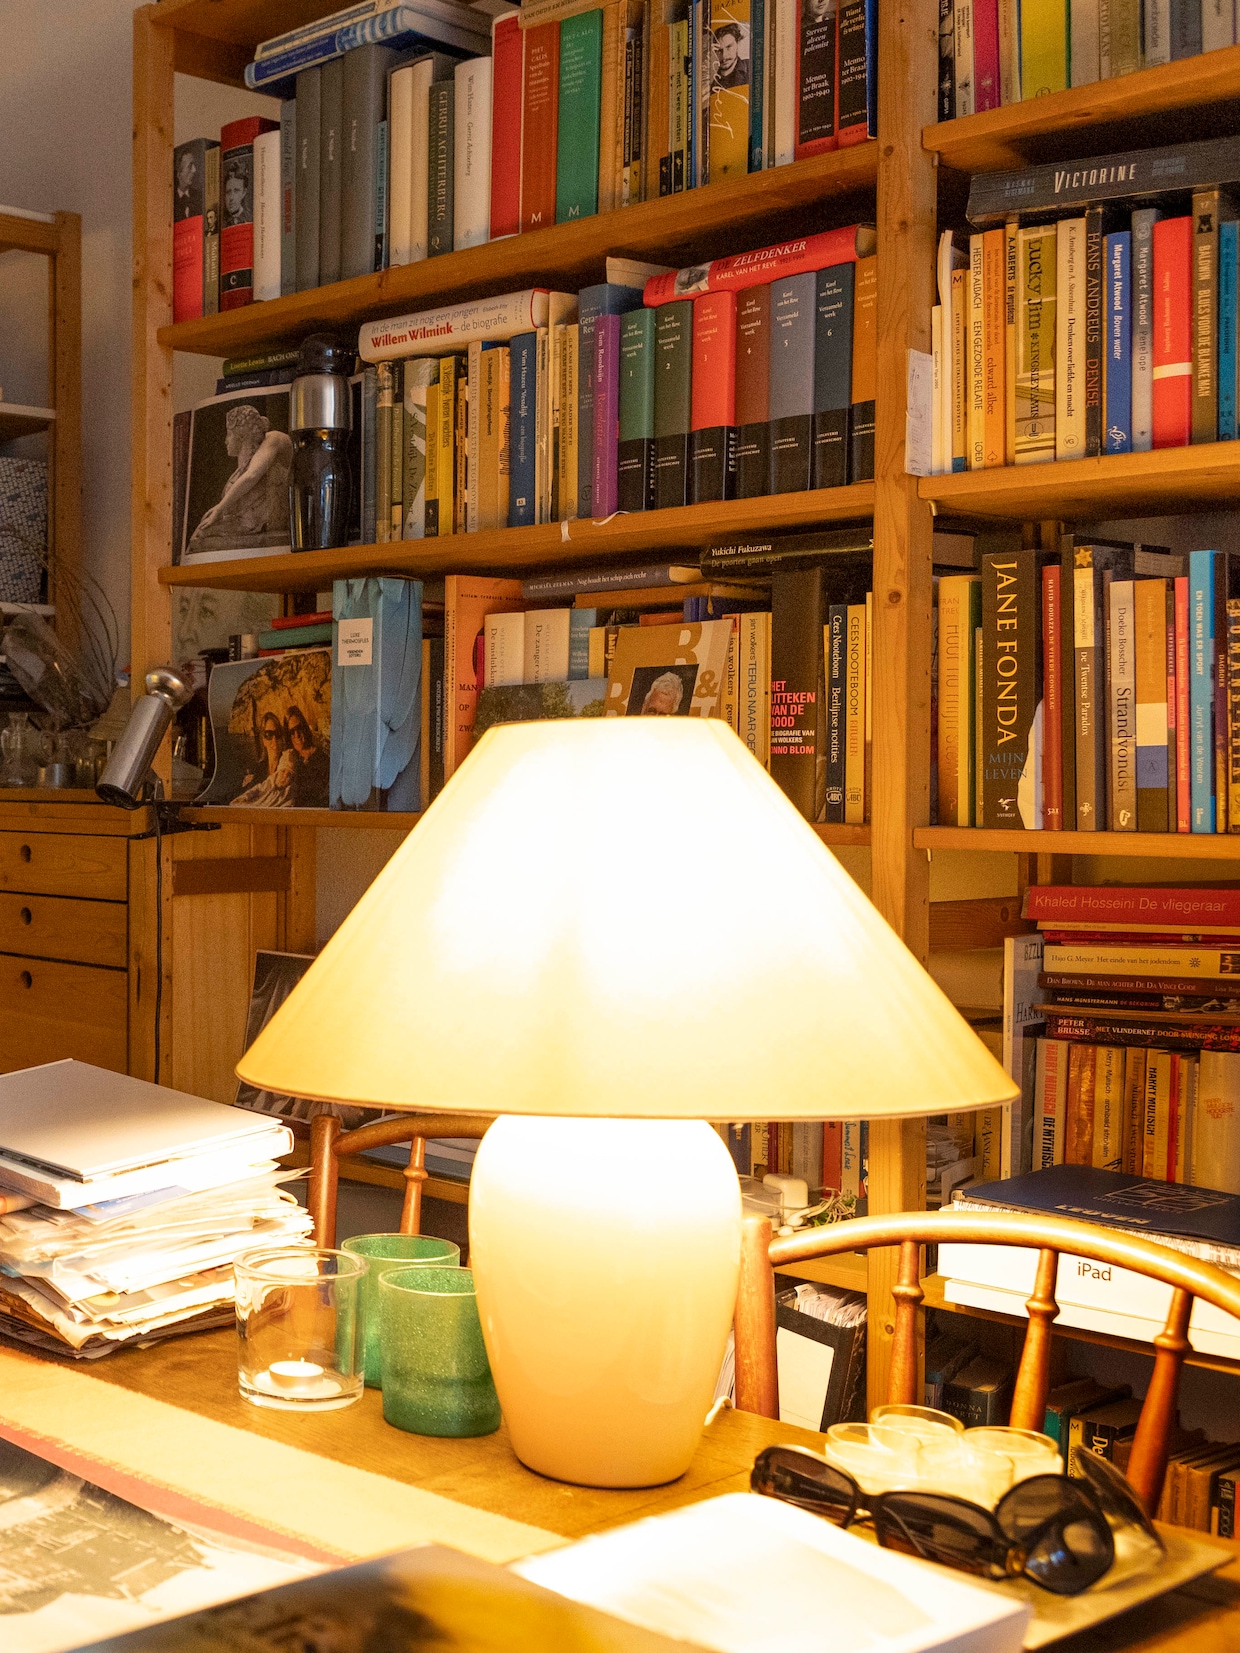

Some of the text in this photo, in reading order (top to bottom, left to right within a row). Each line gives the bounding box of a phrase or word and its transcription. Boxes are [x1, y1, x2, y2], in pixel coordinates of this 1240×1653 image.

[805, 74, 826, 84] Menno
[811, 80, 829, 90] Braak
[436, 91, 447, 221] GERRIT ACHTERBERG
[1054, 164, 1137, 193] VICTORINE
[532, 212, 542, 223] M
[568, 205, 579, 217] M
[1069, 226, 1076, 234] K.
[733, 240, 807, 267] ZELFDENKER
[716, 271, 734, 280] KAREL
[736, 268, 748, 277] VAN
[749, 264, 759, 274] HET
[760, 260, 777, 272] REVE
[1068, 265, 1074, 273] en
[1068, 283, 1076, 314] Steenhuis
[1111, 244, 1123, 360] Margaret Atwood Boven water
[1087, 232, 1100, 407] HANS ANDREUS DENISE
[1137, 247, 1149, 372] Margaret Atwood Penelope
[973, 247, 983, 410] HESTER ALBACH EEN GEZONDE RELATIE
[1027, 239, 1043, 418] Lucky Jim KINGSLEY AMIS
[1197, 244, 1210, 397] BALDWIN BLUES VOOR DE BLANKE MAN
[371, 314, 507, 348] Willem Wilmink de biografie
[827, 329, 832, 337] 6
[1067, 318, 1075, 346] Denken
[1067, 363, 1075, 382] liefde
[986, 357, 997, 415] edward albee
[1067, 384, 1073, 393] en
[1066, 394, 1075, 417] macht
[711, 542, 772, 557] Yukichi Fukuzawa
[1195, 590, 1203, 601] EN
[1195, 602, 1203, 621] TOEN
[749, 618, 757, 629] jan
[1195, 622, 1203, 639] WAS
[749, 631, 757, 660] wolkers
[1048, 636, 1054, 645] DE
[1195, 640, 1203, 650] ER
[990, 560, 1018, 746] JANE FONDA
[1080, 651, 1088, 661] De
[1195, 652, 1203, 676] SPORT
[747, 661, 757, 698] TERUG
[829, 616, 842, 763] Cees Nooteboom Berlijnse notities
[850, 617, 860, 757] CEES NOOTEBOOM RITUELEN
[1080, 664, 1090, 699] Twentse
[459, 704, 470, 712] OP
[790, 704, 804, 715] DE
[1116, 607, 1133, 794] Doeko Bosscher Strandvondst
[747, 700, 756, 731] NAAR
[1079, 702, 1091, 736] Paradox
[1194, 704, 1205, 726] Jurryt
[790, 746, 814, 754] BLOM
[988, 752, 1025, 764] MIJN
[1196, 745, 1204, 755] de
[985, 770, 1027, 780] LEVEN
[1195, 757, 1205, 784] Vooren
[1035, 895, 1228, 915] Khaled Hosseini De vliegeraar
[1051, 954, 1065, 962] Hajo
[1075, 955, 1094, 964] Meyer
[1109, 956, 1126, 964] einde
[1150, 957, 1180, 966] jodendom
[1057, 1027, 1090, 1036] BRUSSE
[1112, 1026, 1156, 1036] VLINDERNET
[1180, 1031, 1218, 1041] SWINGING
[1045, 1044, 1058, 1074] HARRY
[1043, 1075, 1057, 1115] MULISCH
[1102, 1050, 1113, 1158] Harry Mulisch archibald strohalm
[1147, 1067, 1157, 1136] HARRY MULISCH
[983, 1116, 992, 1128] DE
[1042, 1117, 1055, 1127] DE
[1077, 1262, 1112, 1281] iPad
[947, 1401, 982, 1412] DONNA
